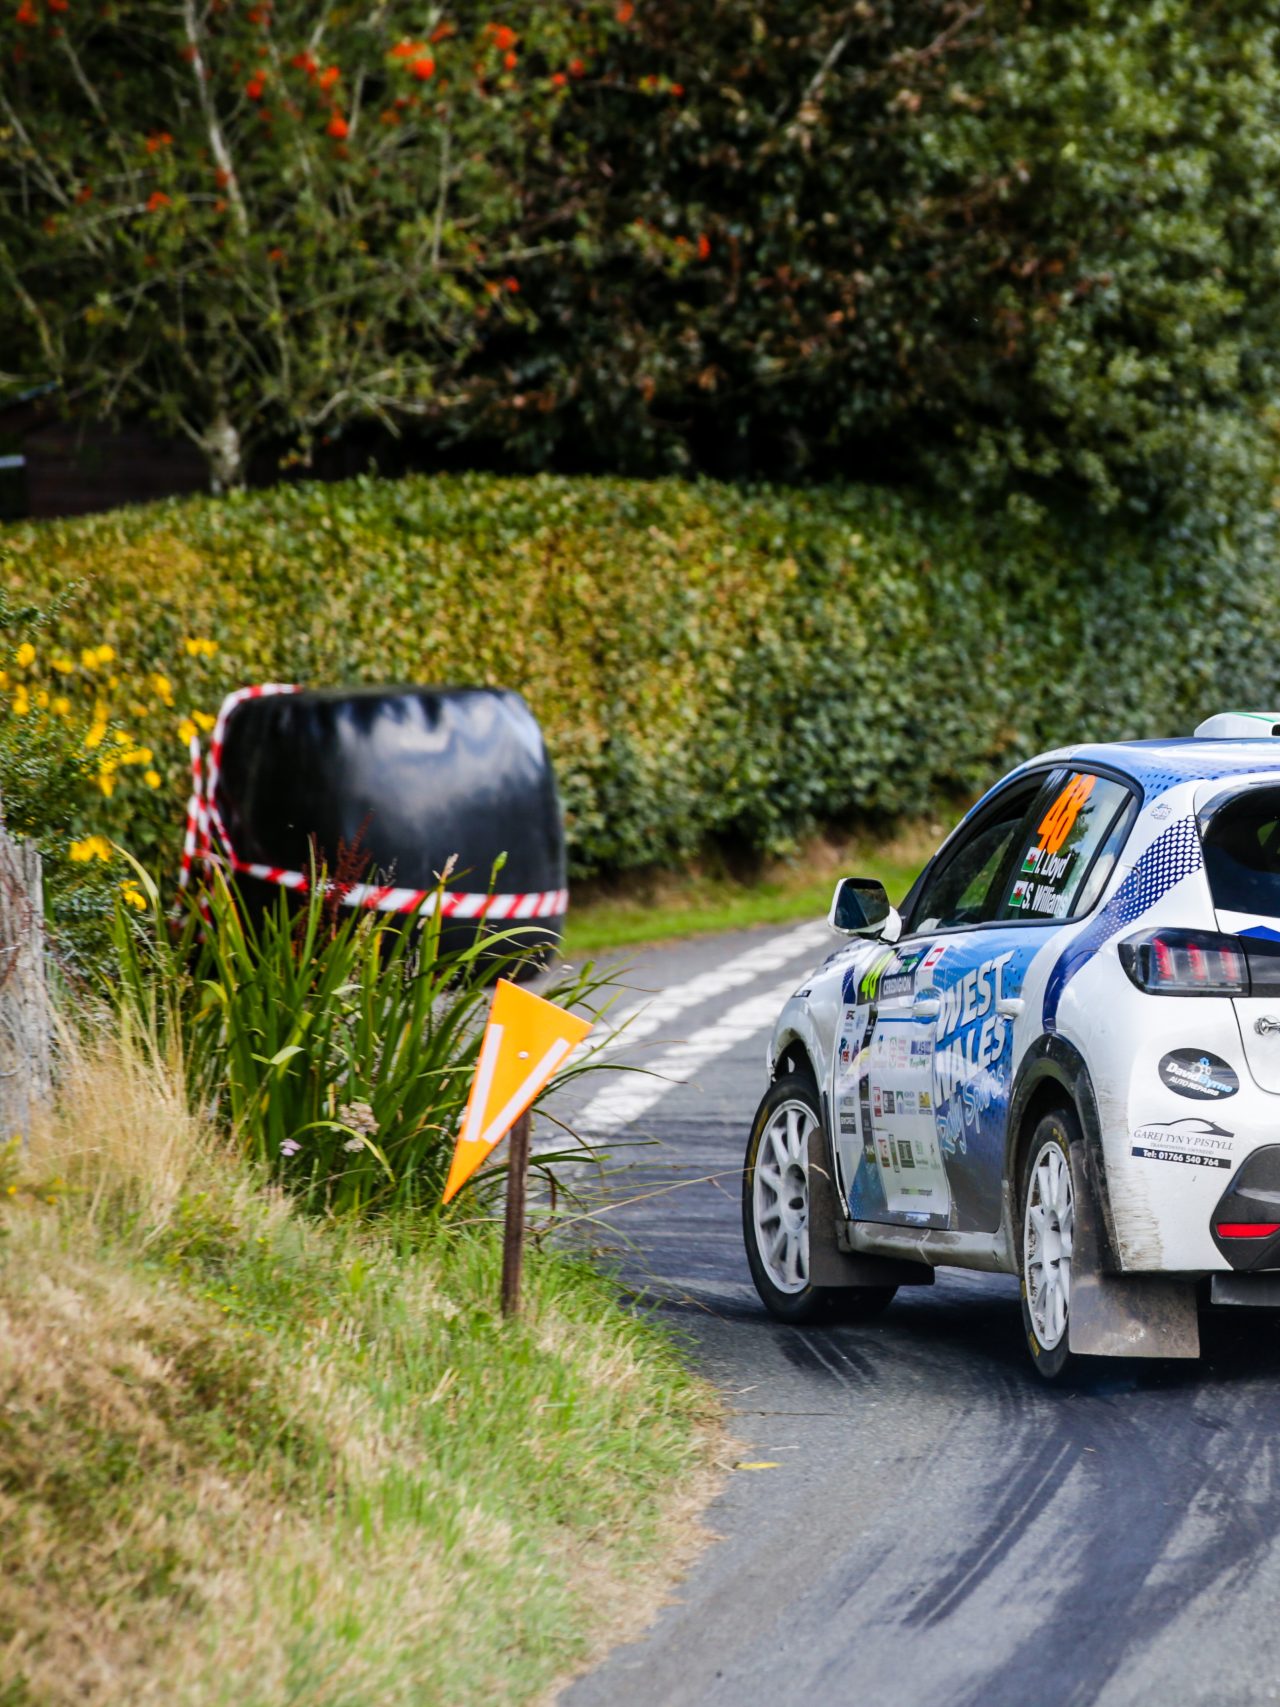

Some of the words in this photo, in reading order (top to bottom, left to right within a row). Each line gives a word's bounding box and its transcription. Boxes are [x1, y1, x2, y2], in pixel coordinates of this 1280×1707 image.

[1037, 774, 1097, 855] 48
[937, 950, 1015, 1043] WEST
[933, 1015, 1006, 1108] WALES
[1169, 1076, 1188, 1087] AUTO
[1188, 1081, 1220, 1096] REPAIRS
[1133, 1129, 1164, 1142] GAREJ
[1166, 1133, 1185, 1144] TYN
[1186, 1136, 1193, 1144] Y
[1193, 1137, 1234, 1151] PISTYLL
[1143, 1149, 1157, 1158] Tel:
[1158, 1152, 1183, 1162] 01766
[1185, 1155, 1201, 1164] 540
[1204, 1157, 1219, 1166] 764
